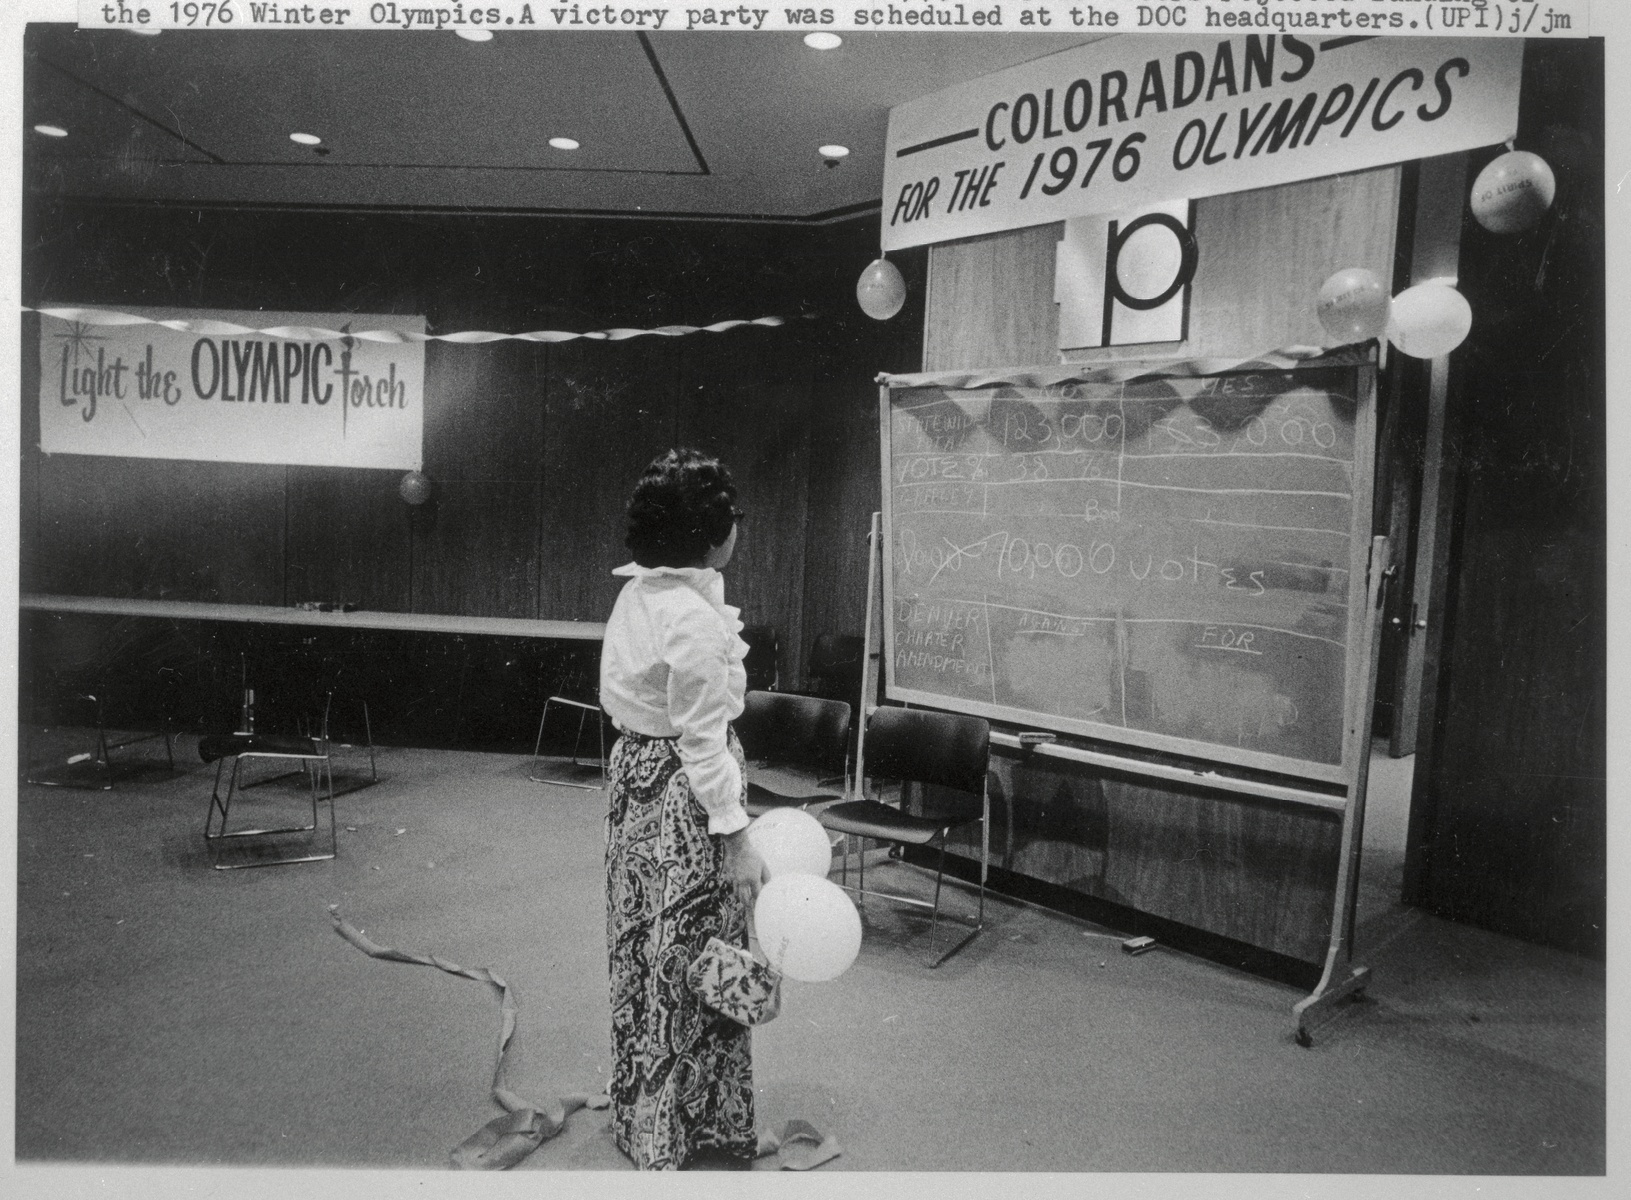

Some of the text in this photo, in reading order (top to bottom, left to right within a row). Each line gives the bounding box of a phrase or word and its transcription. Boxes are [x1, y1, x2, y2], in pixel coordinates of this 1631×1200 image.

[891, 57, 1470, 226] FOR THE 1976 OLYMPICS
[985, 34, 1315, 151] COLORADANS
[60, 344, 129, 422] Light
[134, 344, 182, 406] the
[191, 337, 334, 406] OLYMPIC
[1202, 626, 1255, 652] FOR
